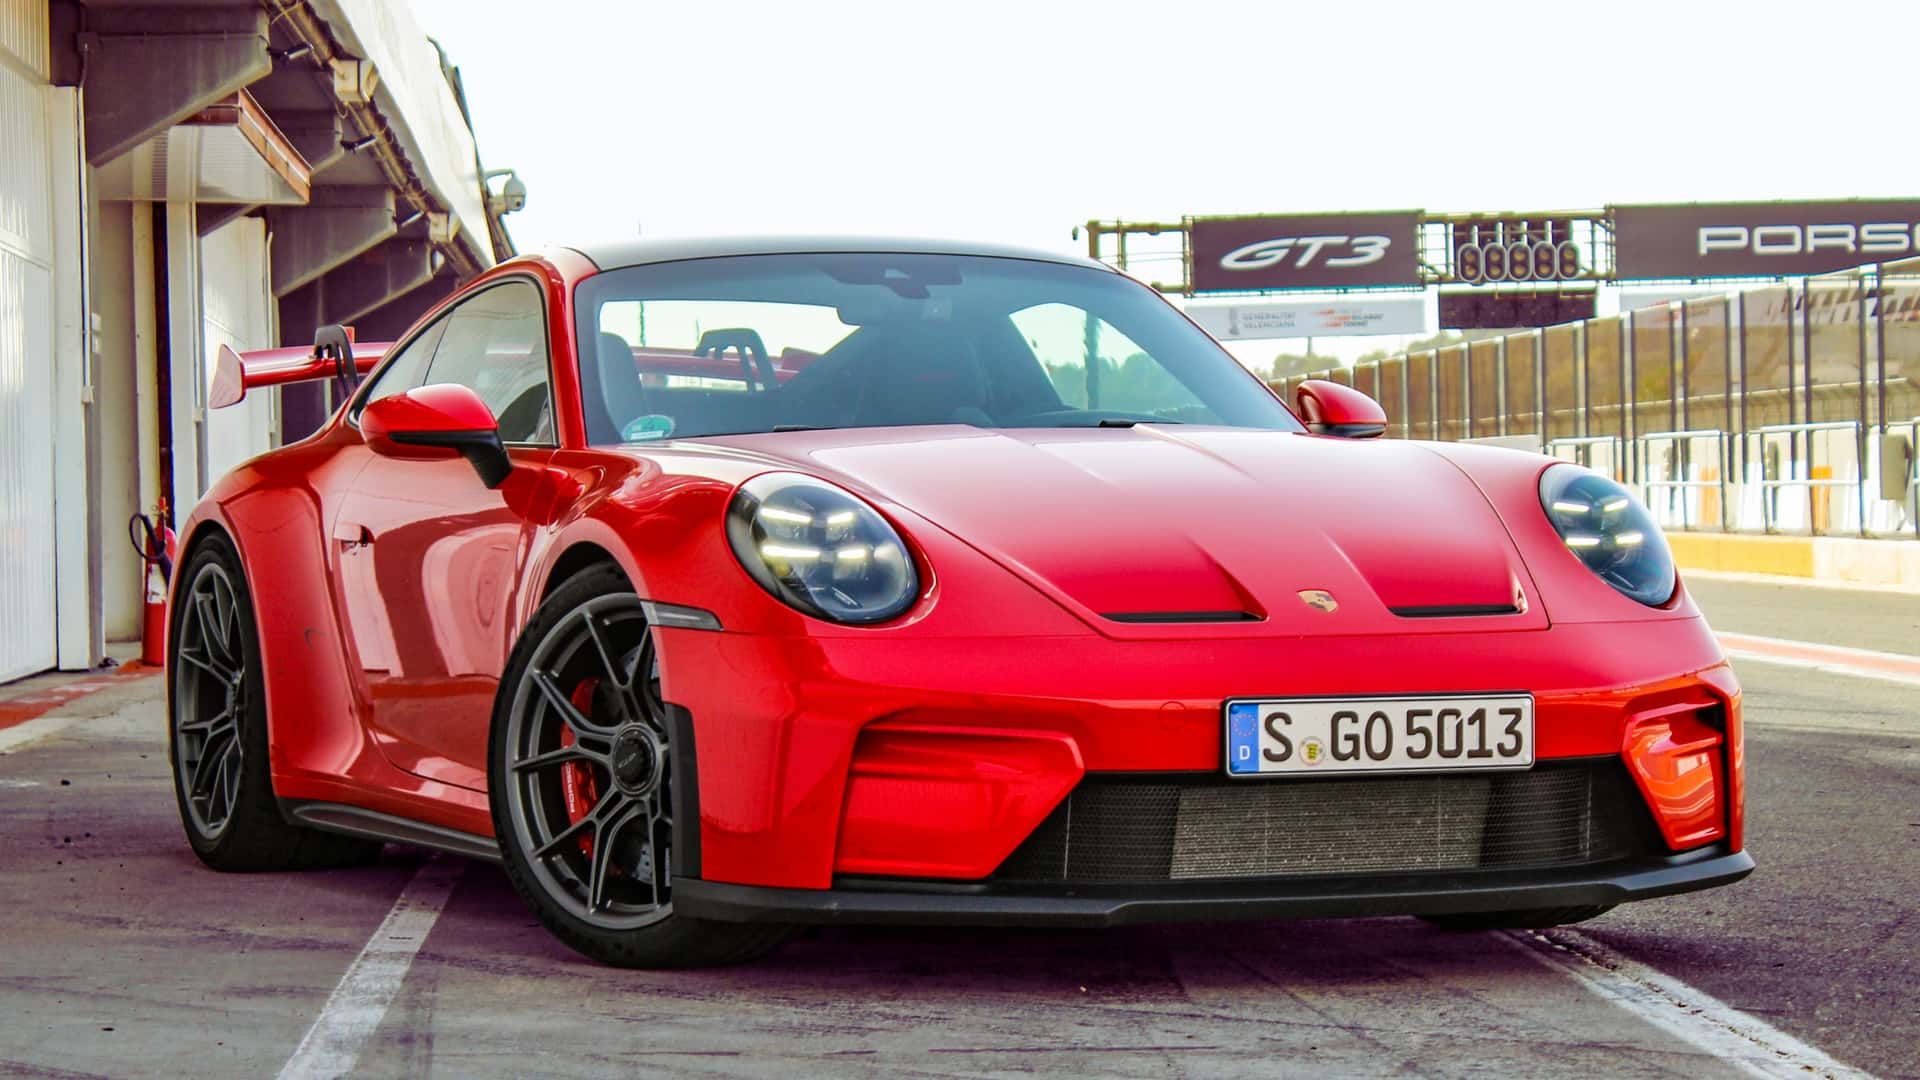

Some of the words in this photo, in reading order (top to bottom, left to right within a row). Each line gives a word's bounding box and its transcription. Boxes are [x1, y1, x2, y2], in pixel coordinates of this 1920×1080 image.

[1220, 235, 1391, 269] GT3
[1699, 223, 1920, 255] PORS
[1263, 711, 1293, 762] S
[1331, 711, 1393, 761] GO
[1406, 708, 1523, 759] 5013
[1240, 745, 1250, 760] D
